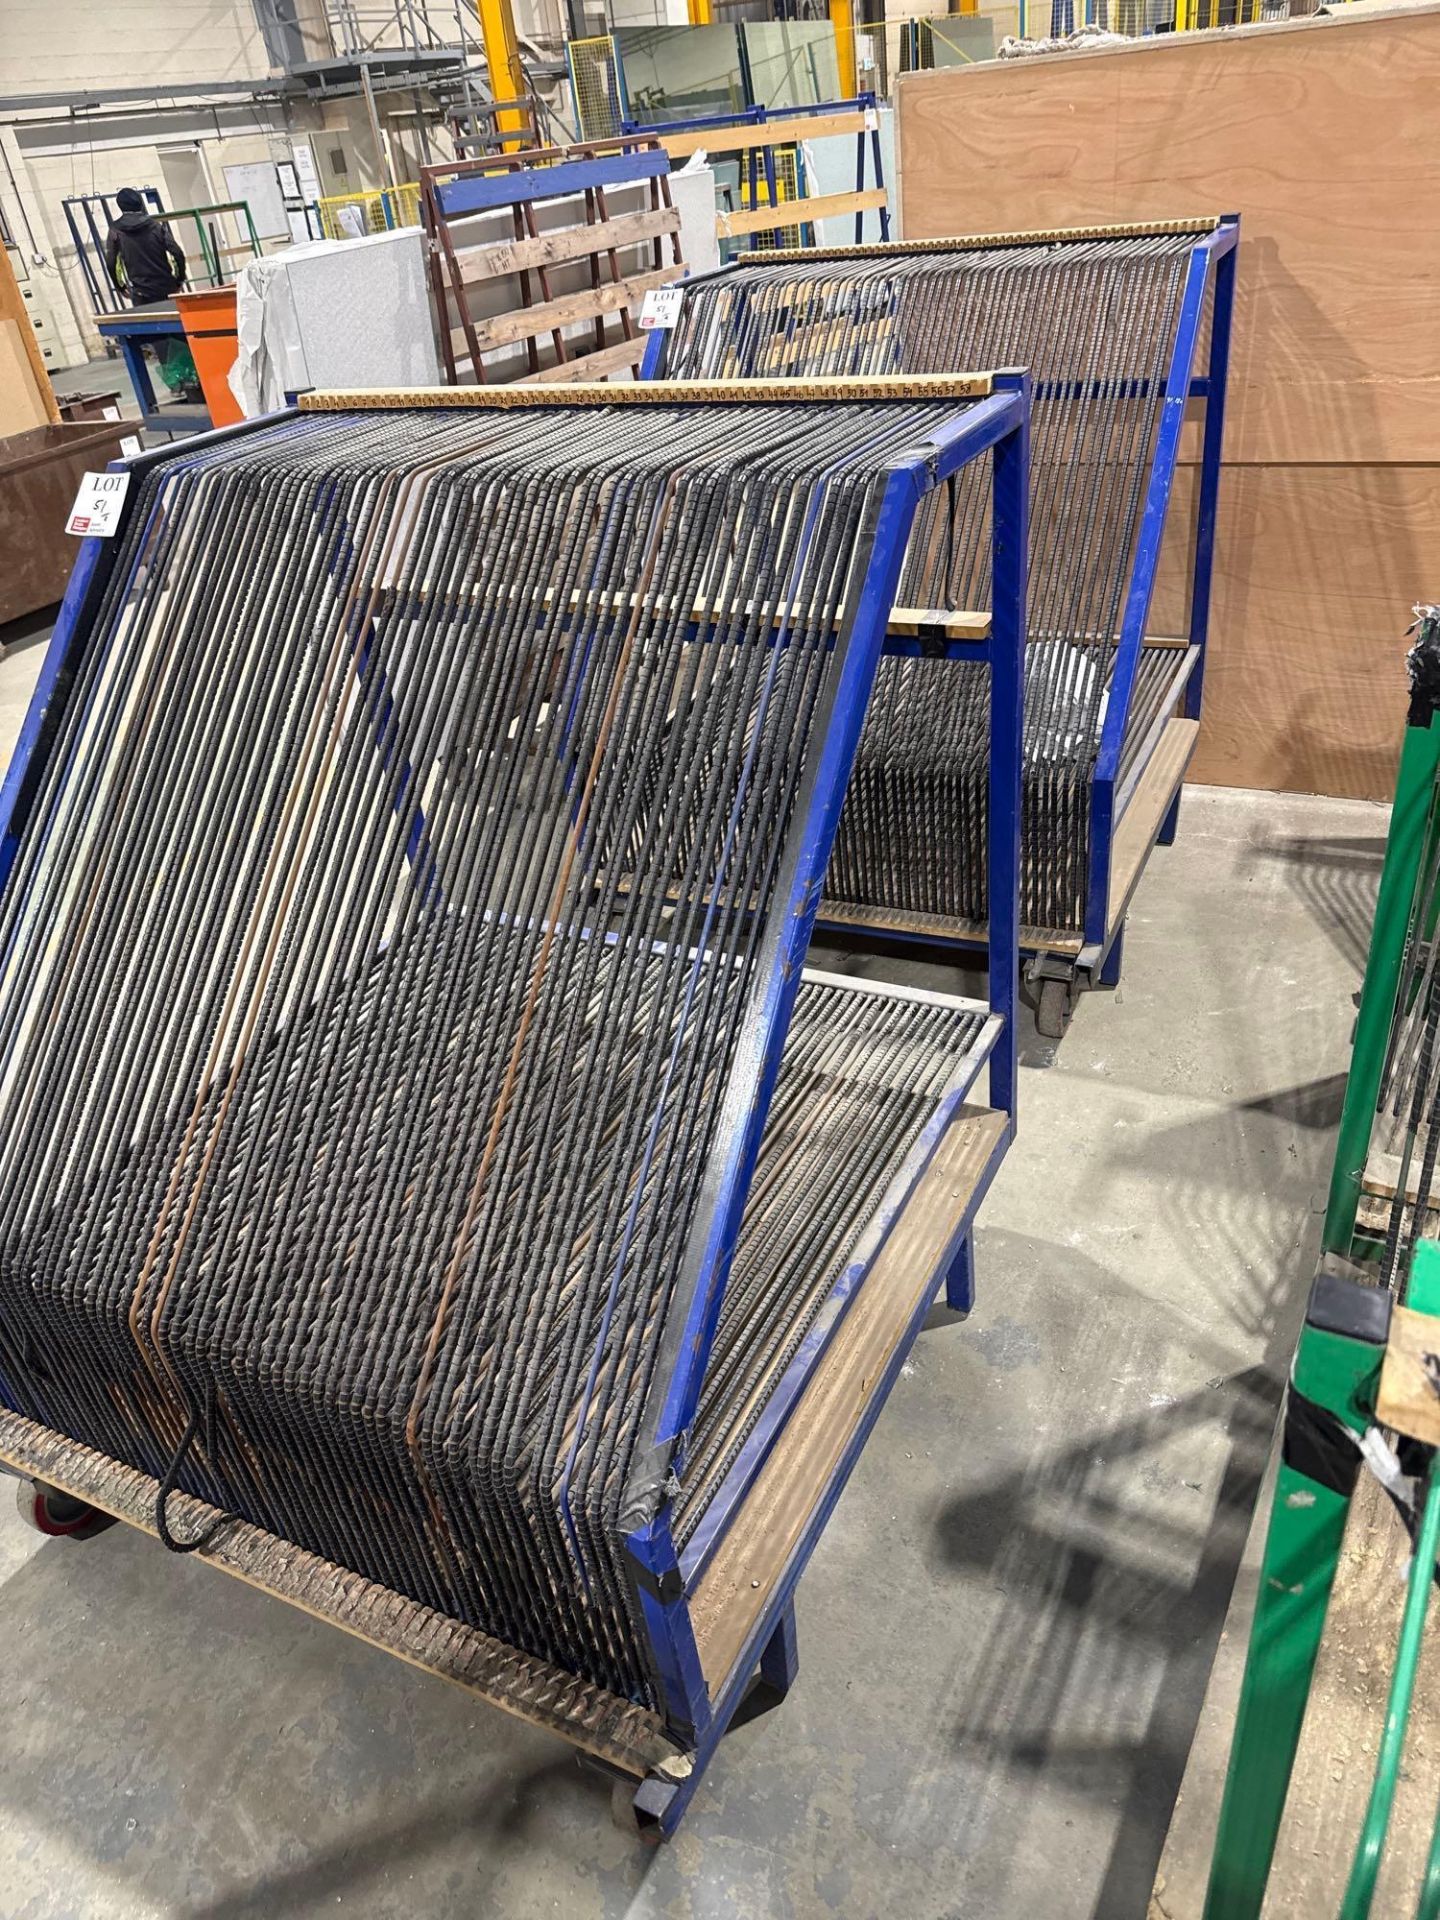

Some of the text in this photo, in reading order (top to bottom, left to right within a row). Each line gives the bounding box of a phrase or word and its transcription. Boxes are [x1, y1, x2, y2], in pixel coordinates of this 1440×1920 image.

[408, 398, 417, 406] 12
[510, 395, 518, 404] 22
[521, 395, 529, 404] 23
[542, 395, 551, 404] 25
[553, 395, 562, 404] 26
[576, 394, 584, 403] 28
[587, 394, 597, 403] 29
[598, 394, 607, 402] 30
[609, 393, 617, 402] 31
[621, 392, 630, 402] 32
[633, 392, 642, 401] 33
[644, 392, 654, 402] 34
[656, 392, 665, 401] 35
[692, 391, 701, 401] 38
[704, 391, 713, 401] 39
[717, 390, 726, 400] 40
[729, 391, 738, 401] 41
[742, 390, 752, 400] 42
[754, 391, 764, 400] 43
[768, 388, 778, 400] 44
[780, 389, 791, 398] 45
[807, 388, 815, 401] 47
[832, 387, 843, 400] 49
[847, 389, 857, 398] 50
[859, 389, 869, 398] 51
[873, 388, 884, 398] 52
[887, 388, 898, 398] 53
[903, 387, 913, 398] 54
[918, 386, 929, 397] 55
[931, 386, 943, 398] 56
[945, 385, 955, 395] 57
[959, 383, 972, 395] 58
[91, 477, 124, 491] LOT
